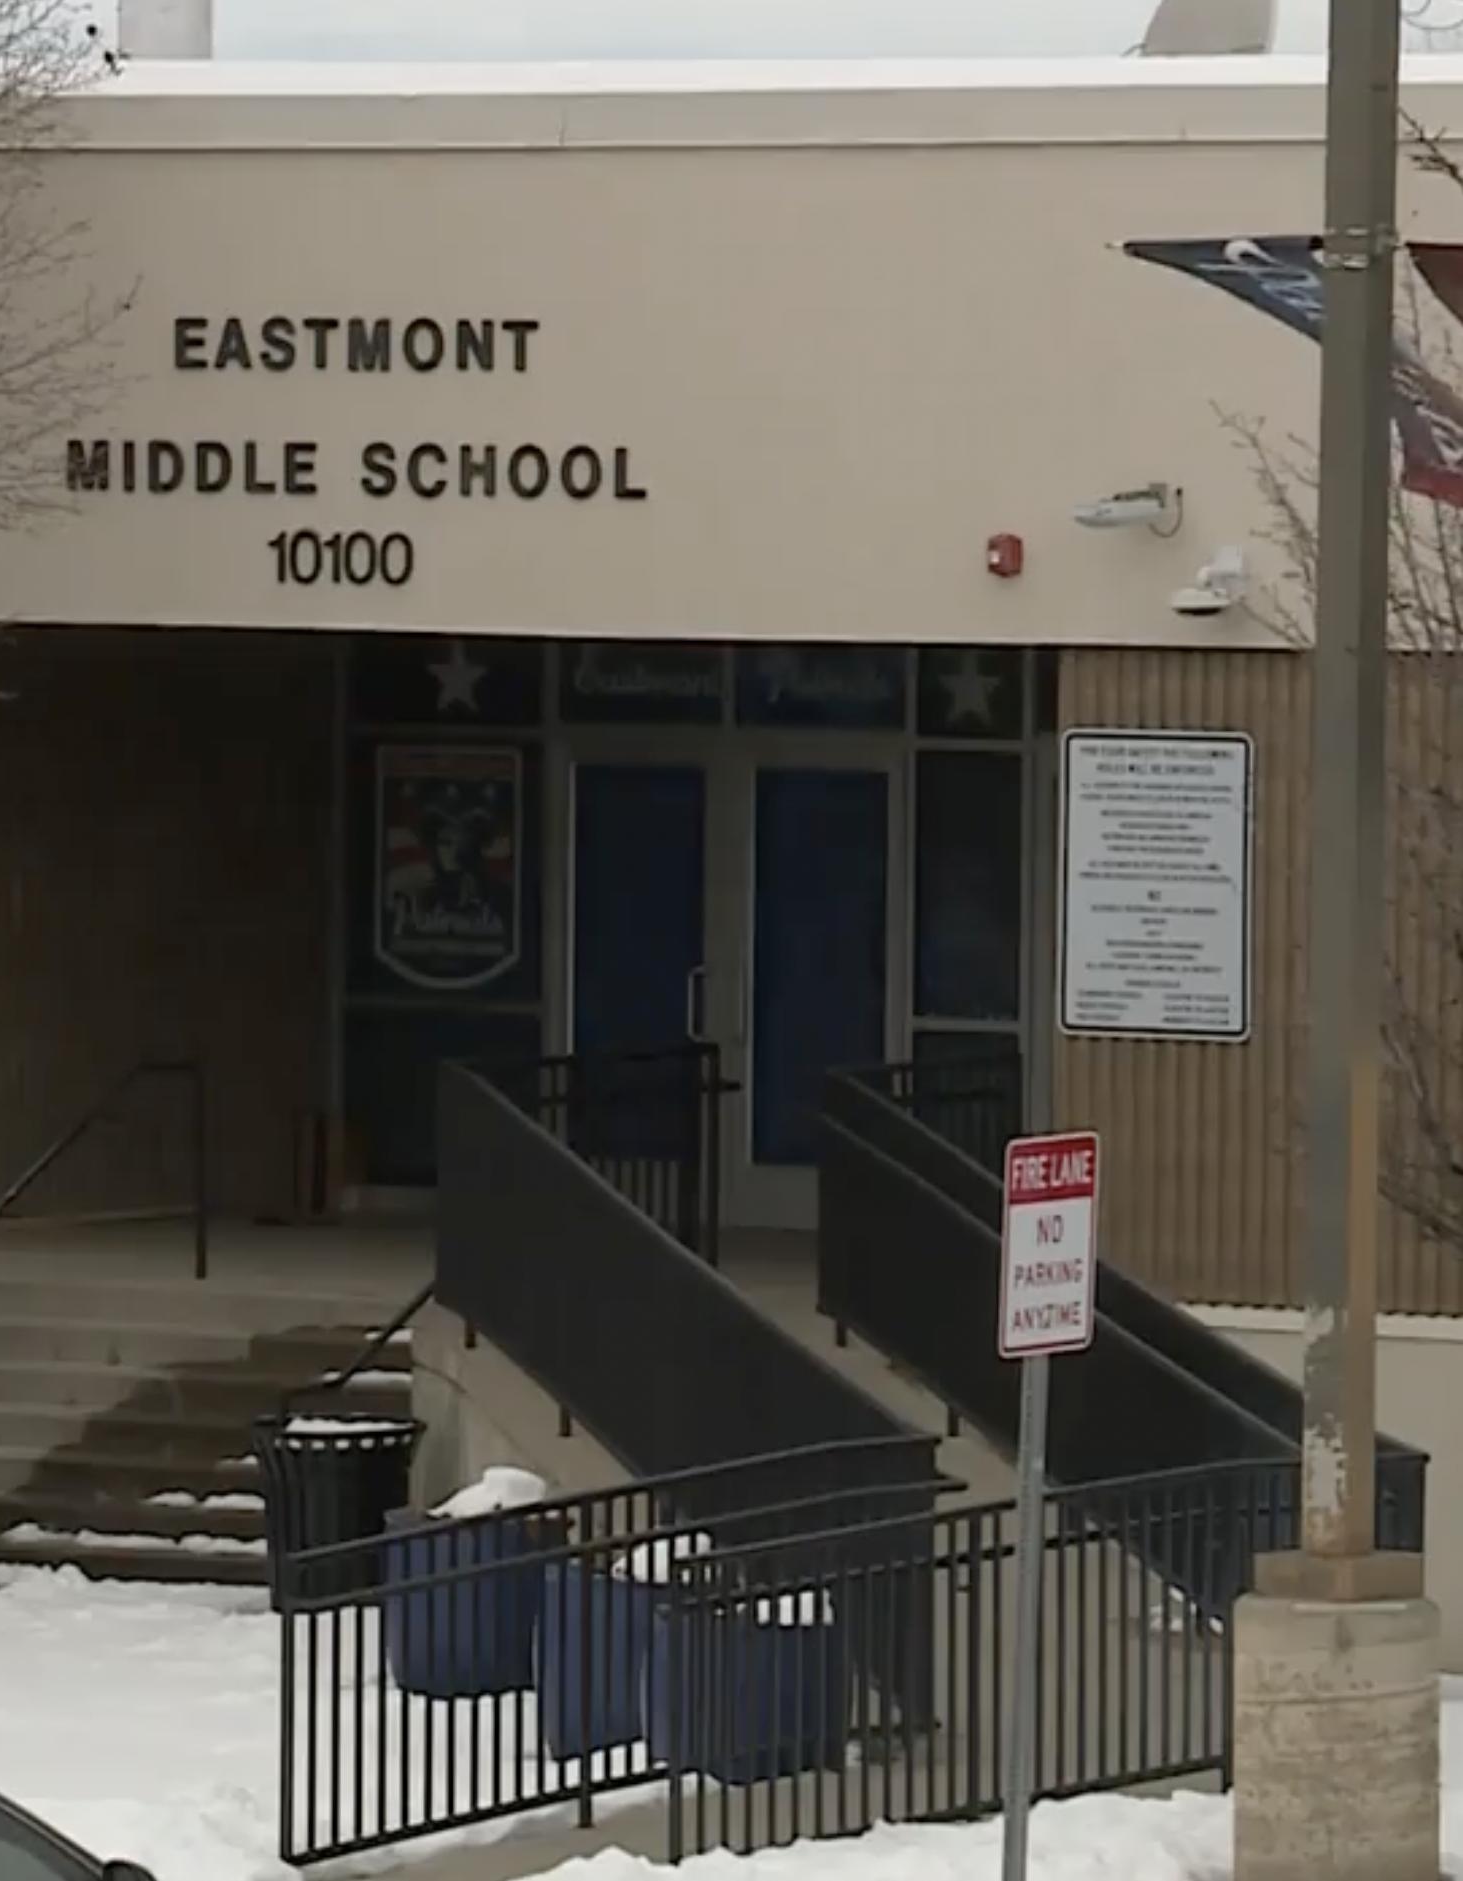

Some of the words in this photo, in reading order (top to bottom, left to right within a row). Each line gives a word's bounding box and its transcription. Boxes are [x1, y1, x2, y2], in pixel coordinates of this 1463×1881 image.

[174, 317, 539, 372] EASTMONT
[66, 439, 318, 495] MIDDLE
[360, 441, 648, 500] SCHOOL
[267, 529, 414, 586] 10100
[1012, 1154, 1048, 1191] FIRE
[1050, 1150, 1093, 1188] LANE
[1037, 1214, 1064, 1248] NO
[1013, 1258, 1083, 1290] PARKING
[1012, 1302, 1083, 1332] ANYTIME
